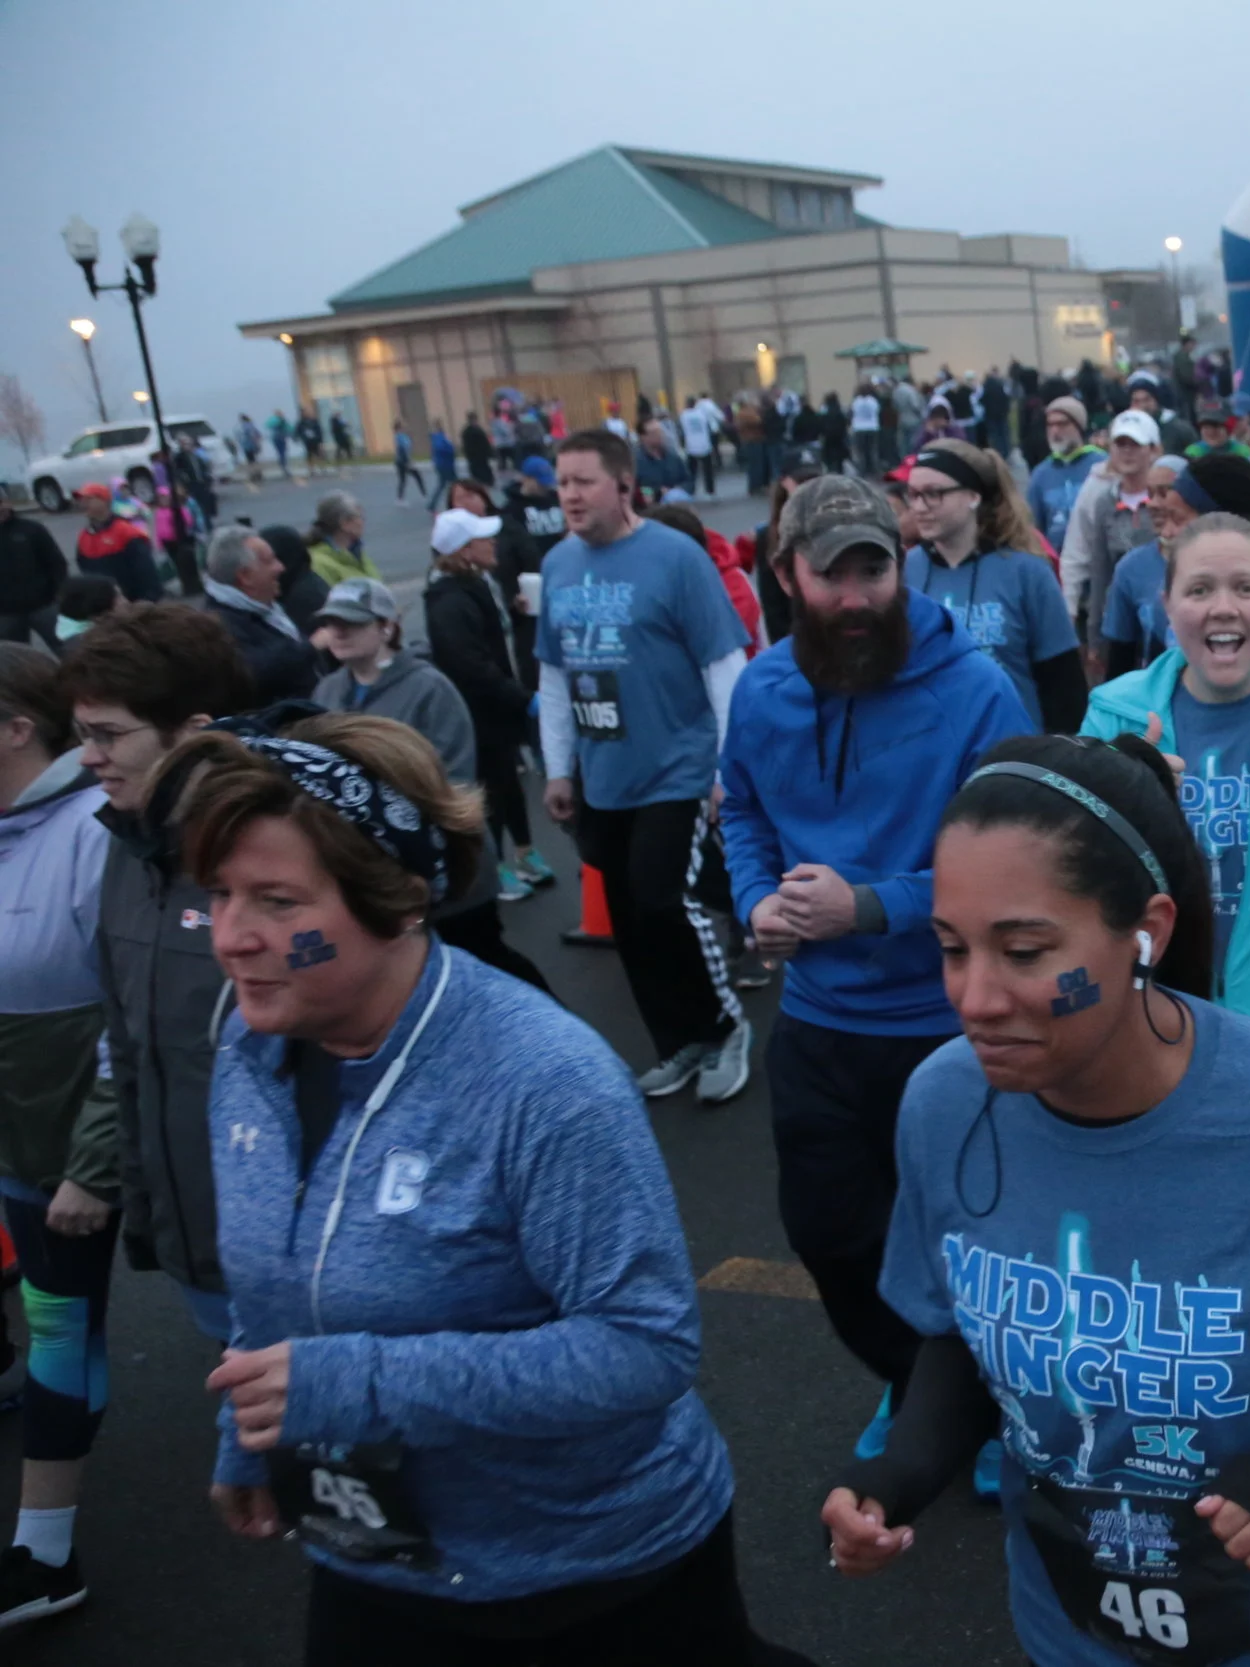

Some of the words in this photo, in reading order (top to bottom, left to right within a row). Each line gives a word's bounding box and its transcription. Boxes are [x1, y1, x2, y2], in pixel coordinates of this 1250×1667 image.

[942, 1233, 1246, 1356] MIDDLE
[953, 1301, 1249, 1419] FINGER
[1123, 1457, 1196, 1480] GENEVA,
[1133, 1424, 1205, 1464] 5K
[310, 1467, 387, 1529] 45
[1100, 1580, 1189, 1648] 46
